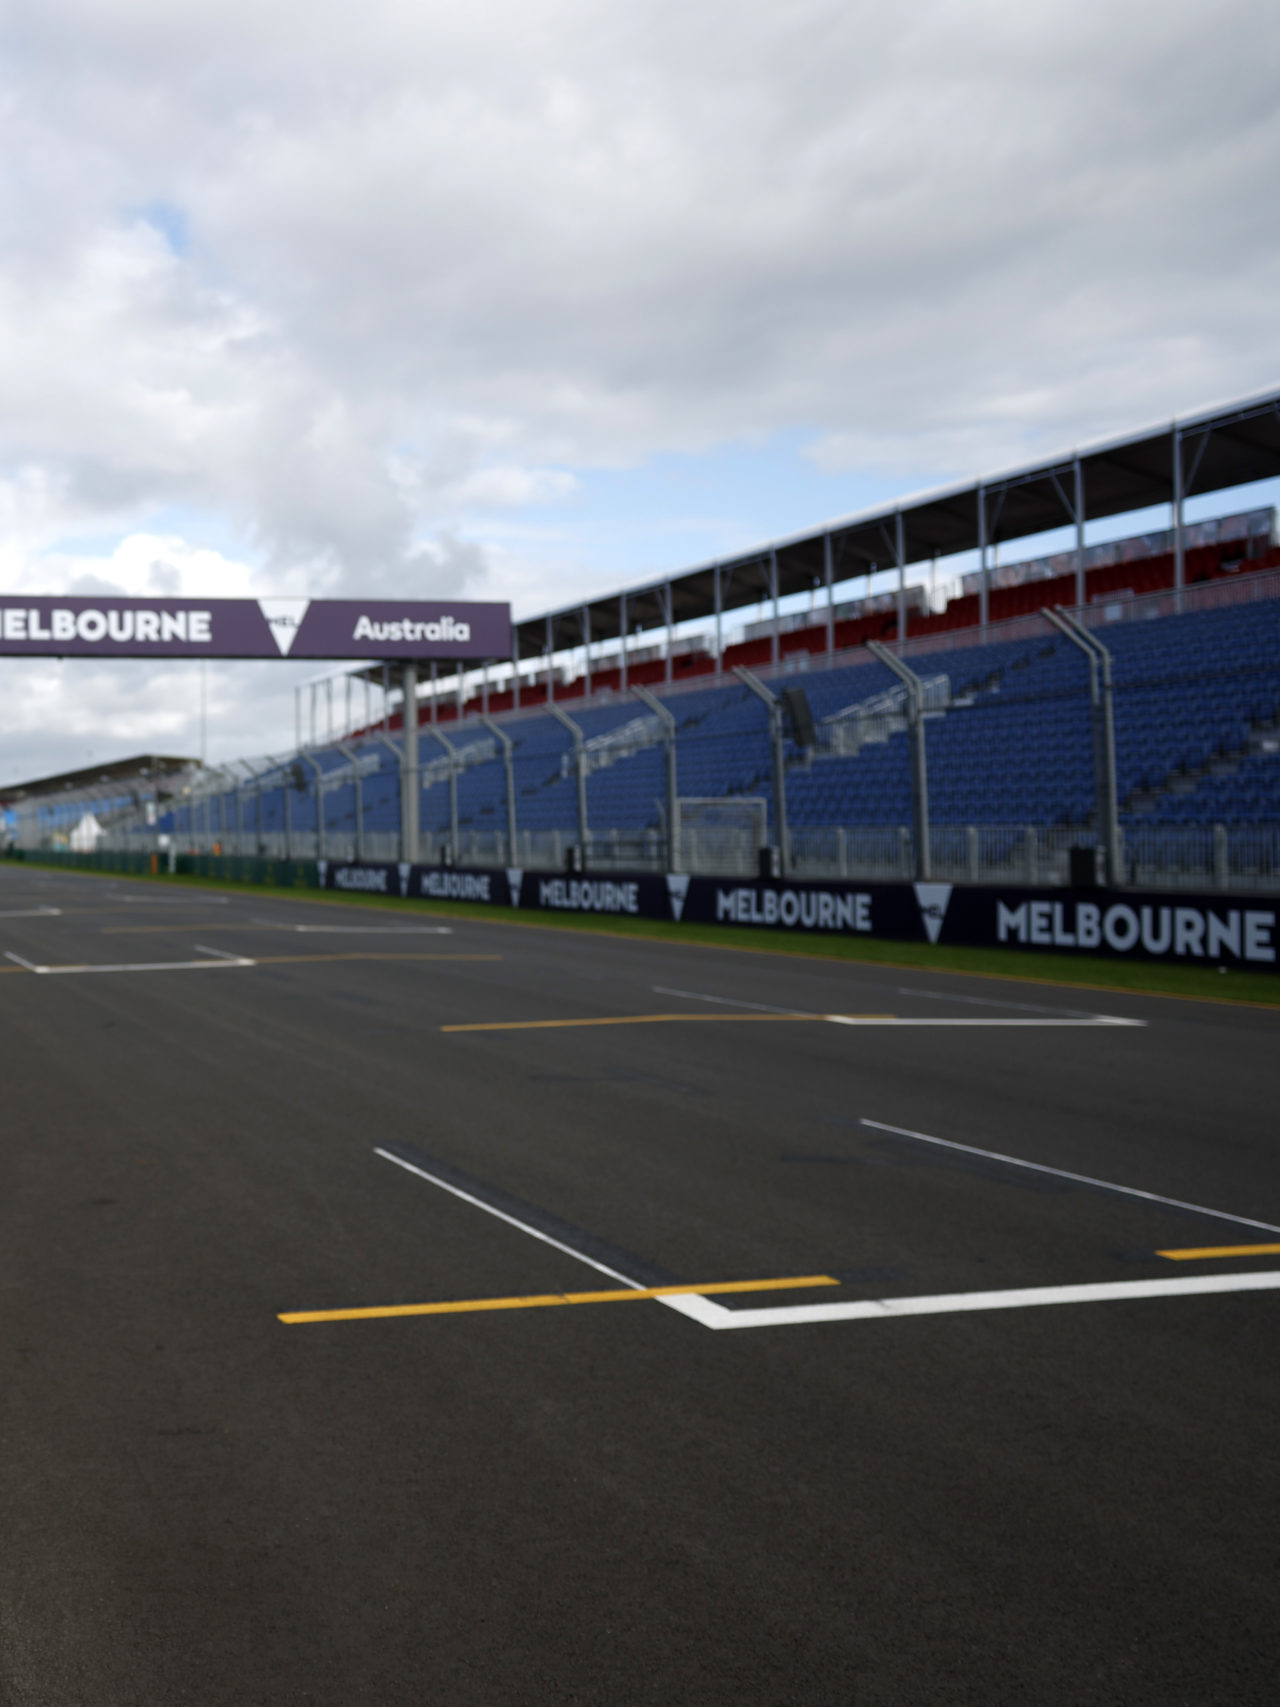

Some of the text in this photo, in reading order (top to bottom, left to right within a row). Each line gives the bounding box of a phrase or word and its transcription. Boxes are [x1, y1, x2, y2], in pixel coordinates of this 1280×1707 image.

[352, 614, 471, 642] Australia
[539, 879, 639, 914] MELBOURNE
[716, 888, 873, 932] MELBOURNE
[996, 900, 1277, 962] MELBOURNE
